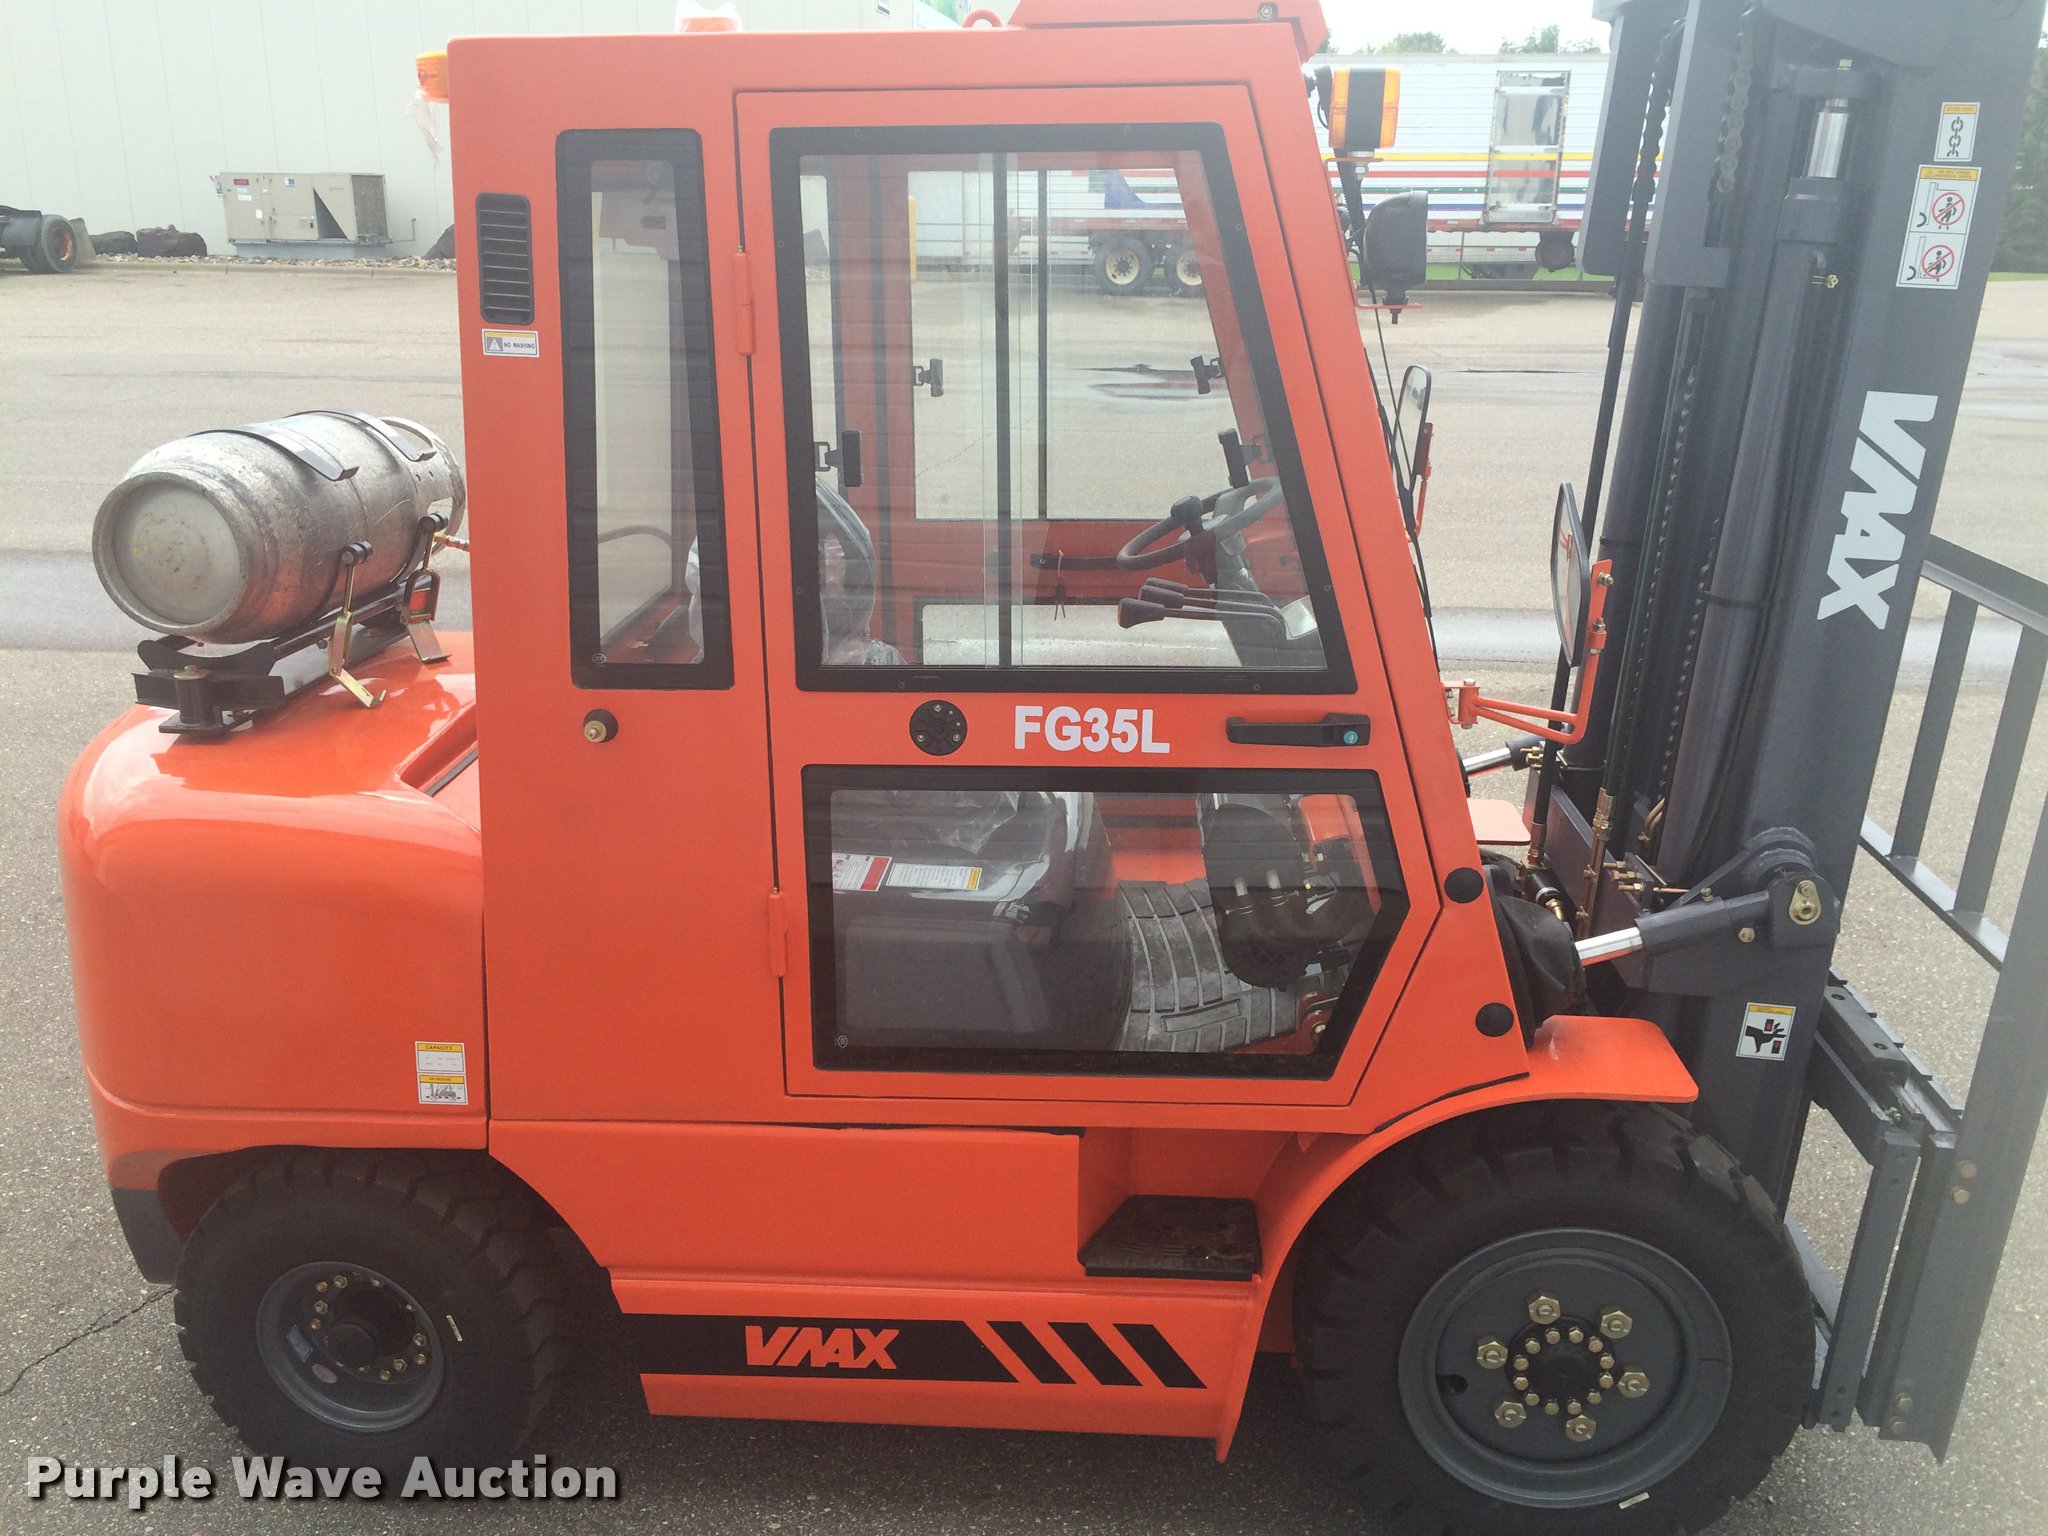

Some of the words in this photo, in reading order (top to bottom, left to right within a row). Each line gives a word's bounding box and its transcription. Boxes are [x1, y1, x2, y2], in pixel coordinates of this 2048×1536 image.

[1817, 391, 1939, 630] VMAX
[1014, 705, 1171, 754] FG35L
[744, 1325, 900, 1370] VMAX
